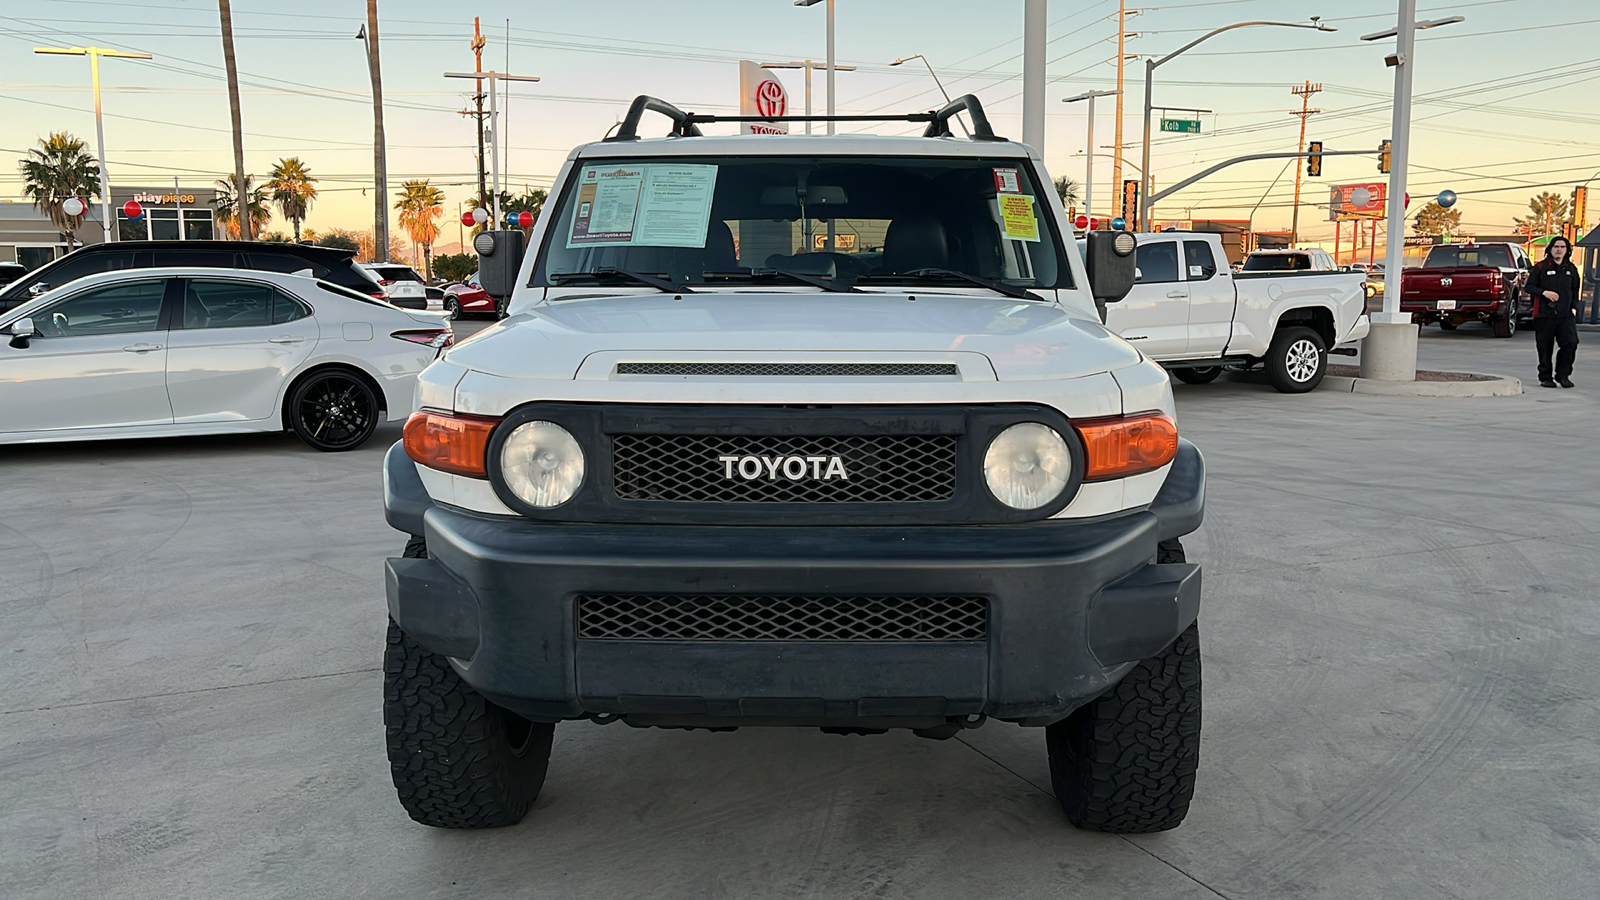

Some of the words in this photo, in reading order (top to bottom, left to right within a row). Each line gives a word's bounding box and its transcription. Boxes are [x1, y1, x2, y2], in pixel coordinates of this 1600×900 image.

[1165, 120, 1179, 131] Kolb
[133, 191, 195, 204] playplace
[1404, 236, 1433, 244] nterprise
[719, 456, 848, 480] TOYOTA
